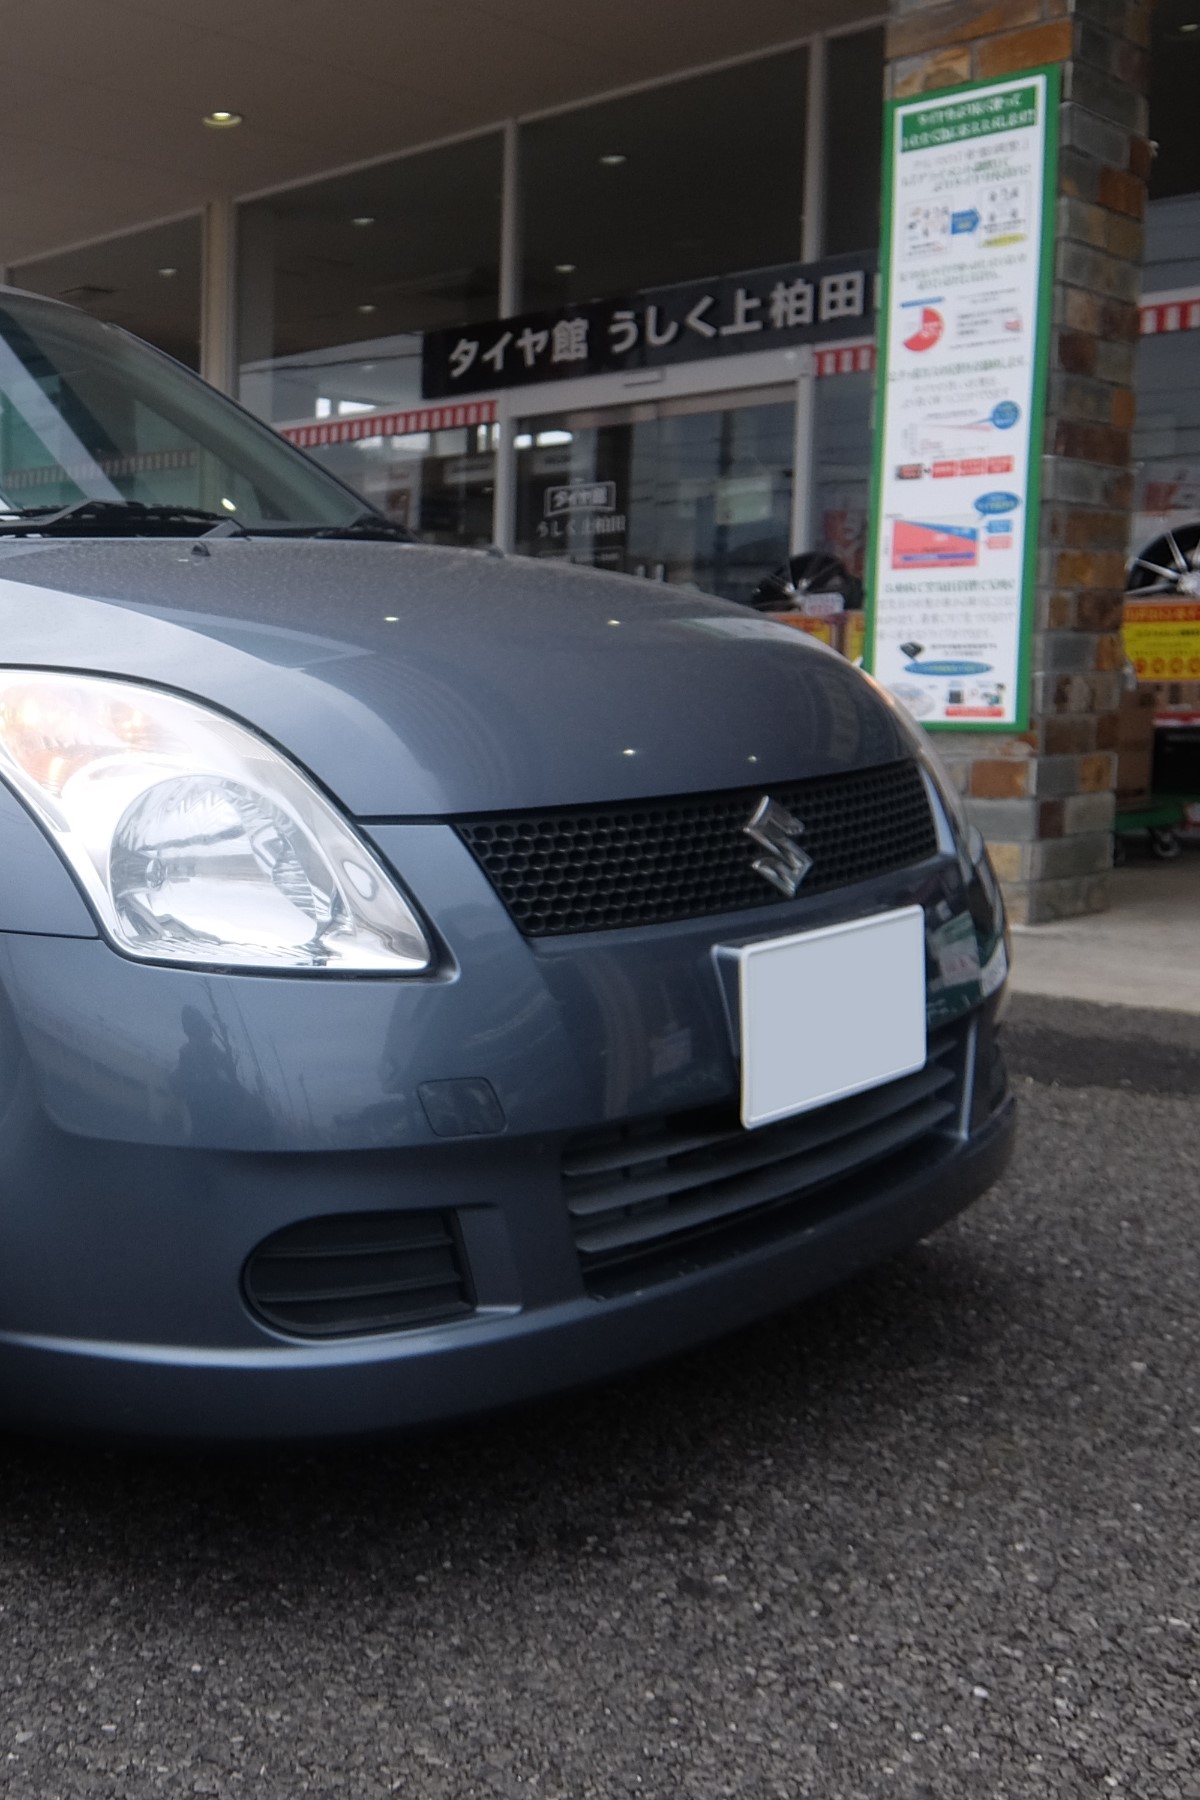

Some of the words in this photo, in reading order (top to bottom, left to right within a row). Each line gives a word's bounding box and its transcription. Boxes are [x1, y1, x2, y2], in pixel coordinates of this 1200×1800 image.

[449, 319, 588, 378] タイヤ館
[608, 271, 864, 353] うしく上柏田
